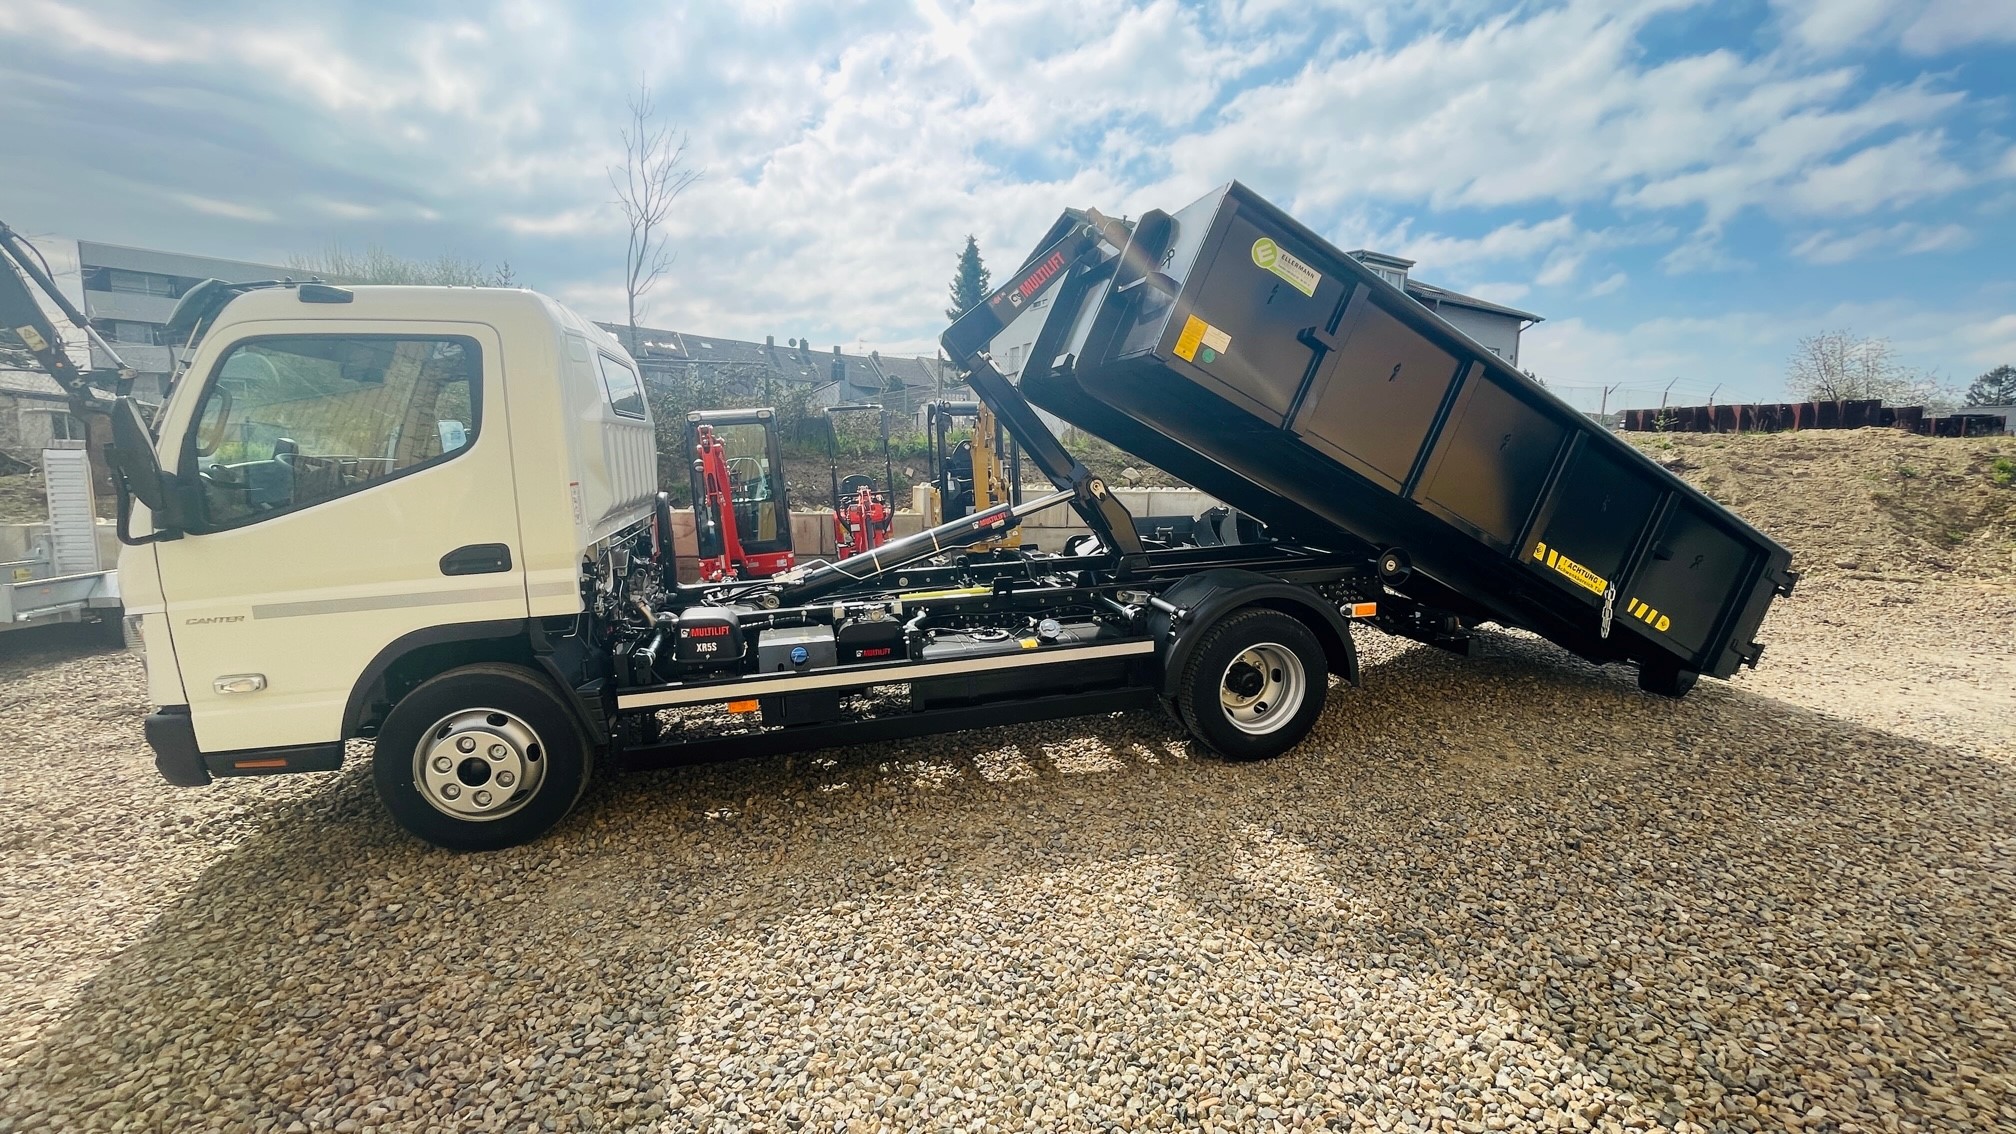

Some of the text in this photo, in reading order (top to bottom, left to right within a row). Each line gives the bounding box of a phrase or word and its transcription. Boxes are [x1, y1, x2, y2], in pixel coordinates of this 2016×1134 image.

[1019, 251, 1065, 297] MULTILIFT
[1281, 254, 1315, 279] ELLERMANN
[1567, 562, 1599, 584] ACHTUNG
[185, 615, 245, 625] CANTER
[691, 625, 730, 637] MULTILIFT
[696, 642, 718, 652] XR5S
